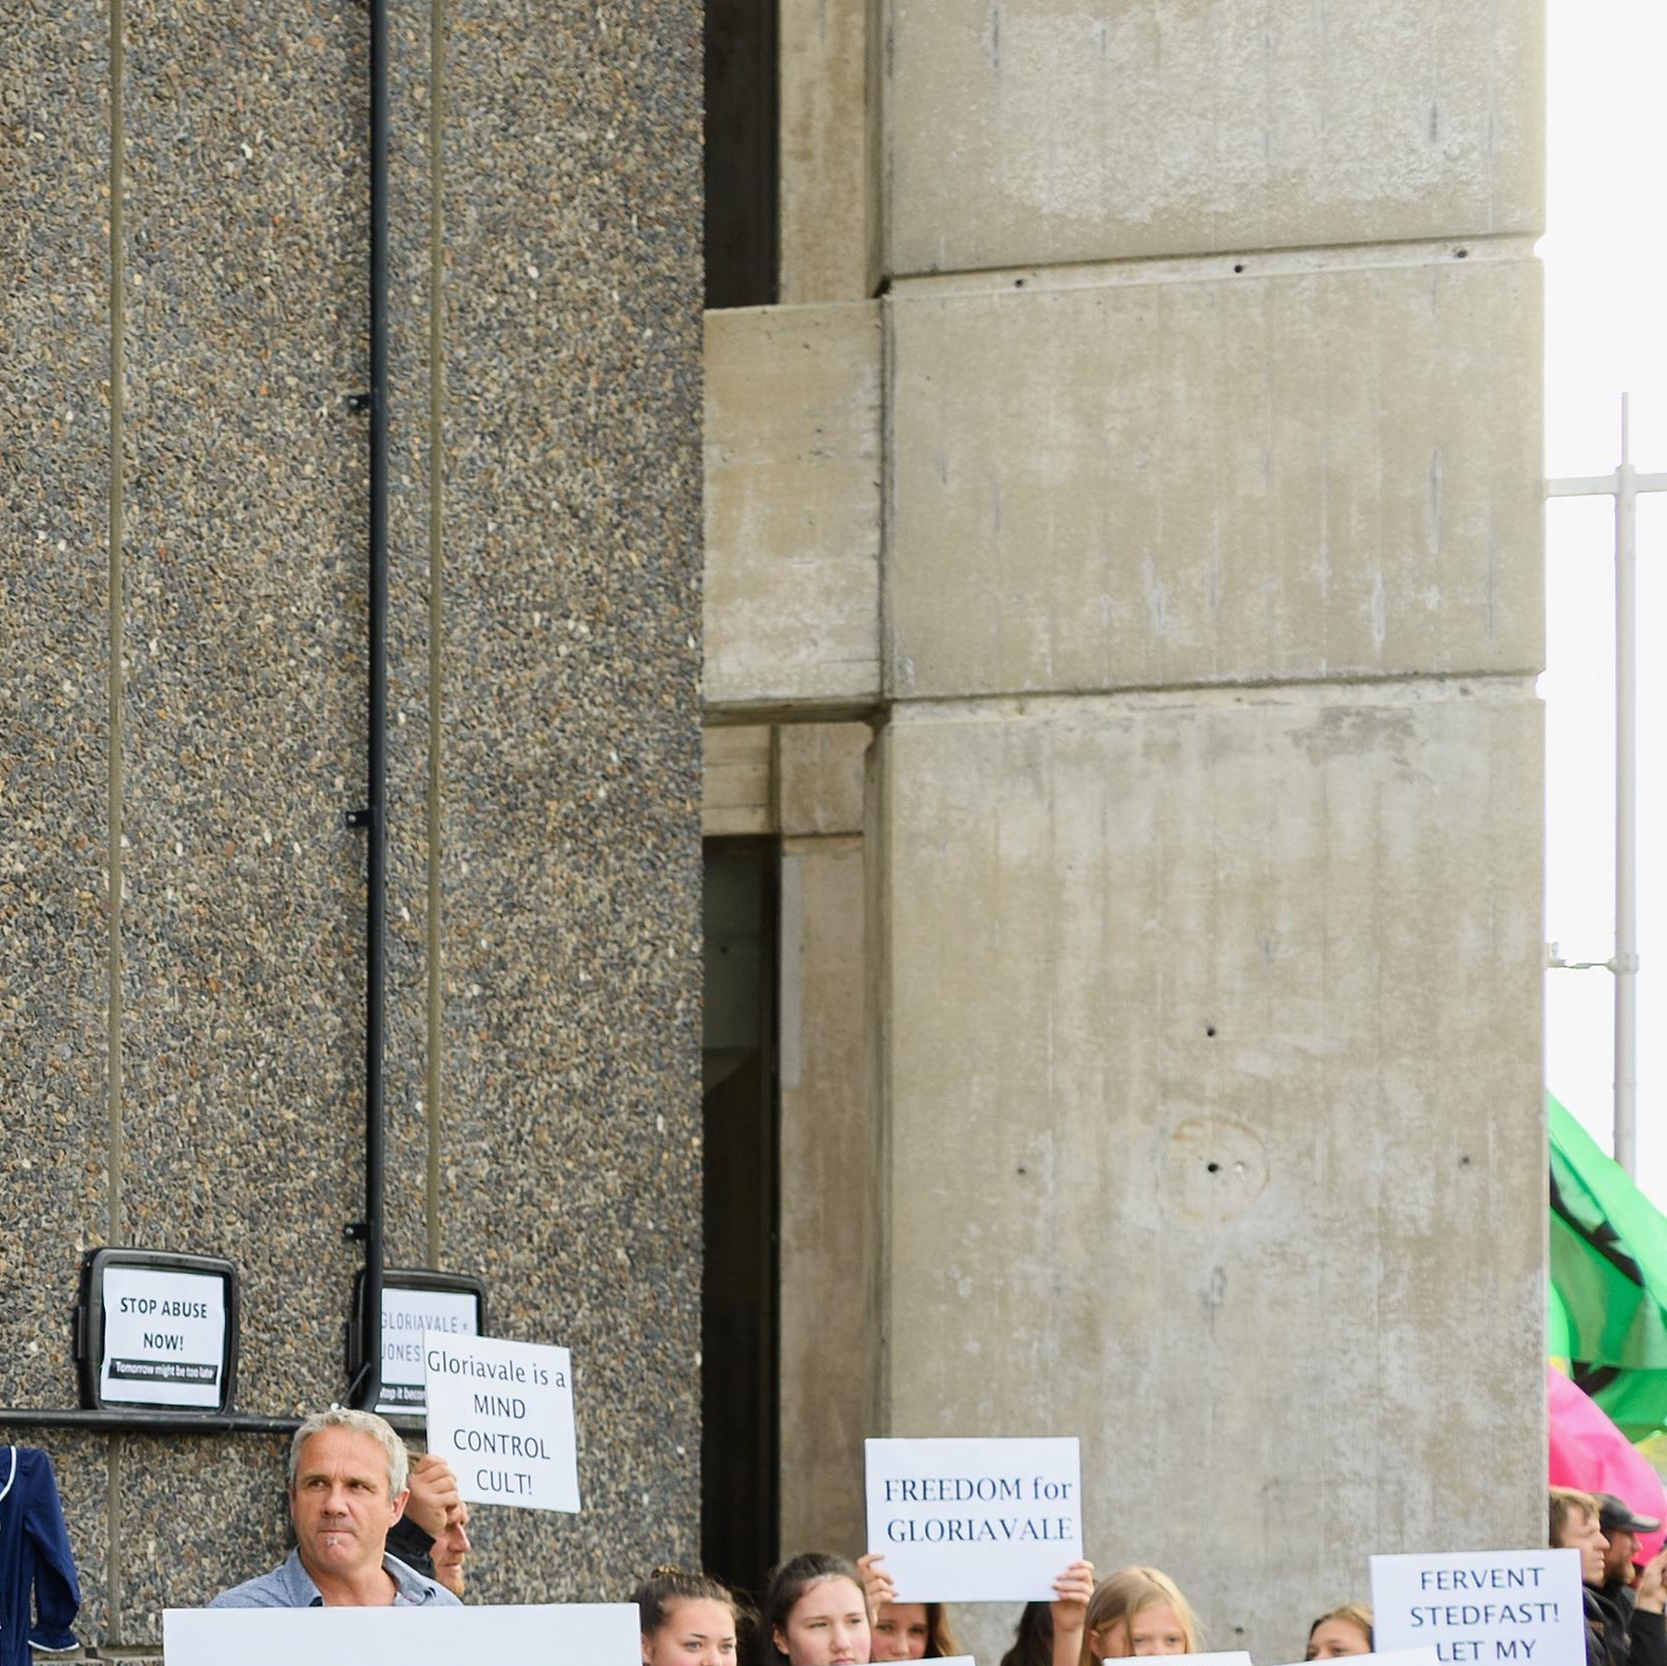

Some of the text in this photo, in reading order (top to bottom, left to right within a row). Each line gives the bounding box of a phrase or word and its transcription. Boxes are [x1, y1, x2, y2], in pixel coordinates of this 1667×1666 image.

[120, 1297, 207, 1318] STOP ABUSE
[381, 1312, 458, 1334] GLORIAVALE
[143, 1333, 183, 1350] NOW!
[381, 1344, 425, 1362] JONES
[428, 1351, 566, 1388] Gloriavale is a
[474, 1394, 526, 1419] MIND
[454, 1429, 550, 1460] CONTROL
[476, 1469, 533, 1495] CULT!
[884, 1476, 1072, 1502] FREEDOM for
[887, 1518, 1073, 1543] GLORIAVALE
[1421, 1567, 1545, 1590] FERVENT
[1411, 1603, 1559, 1627] STEDFAST!
[1436, 1639, 1536, 1662] LET MY
